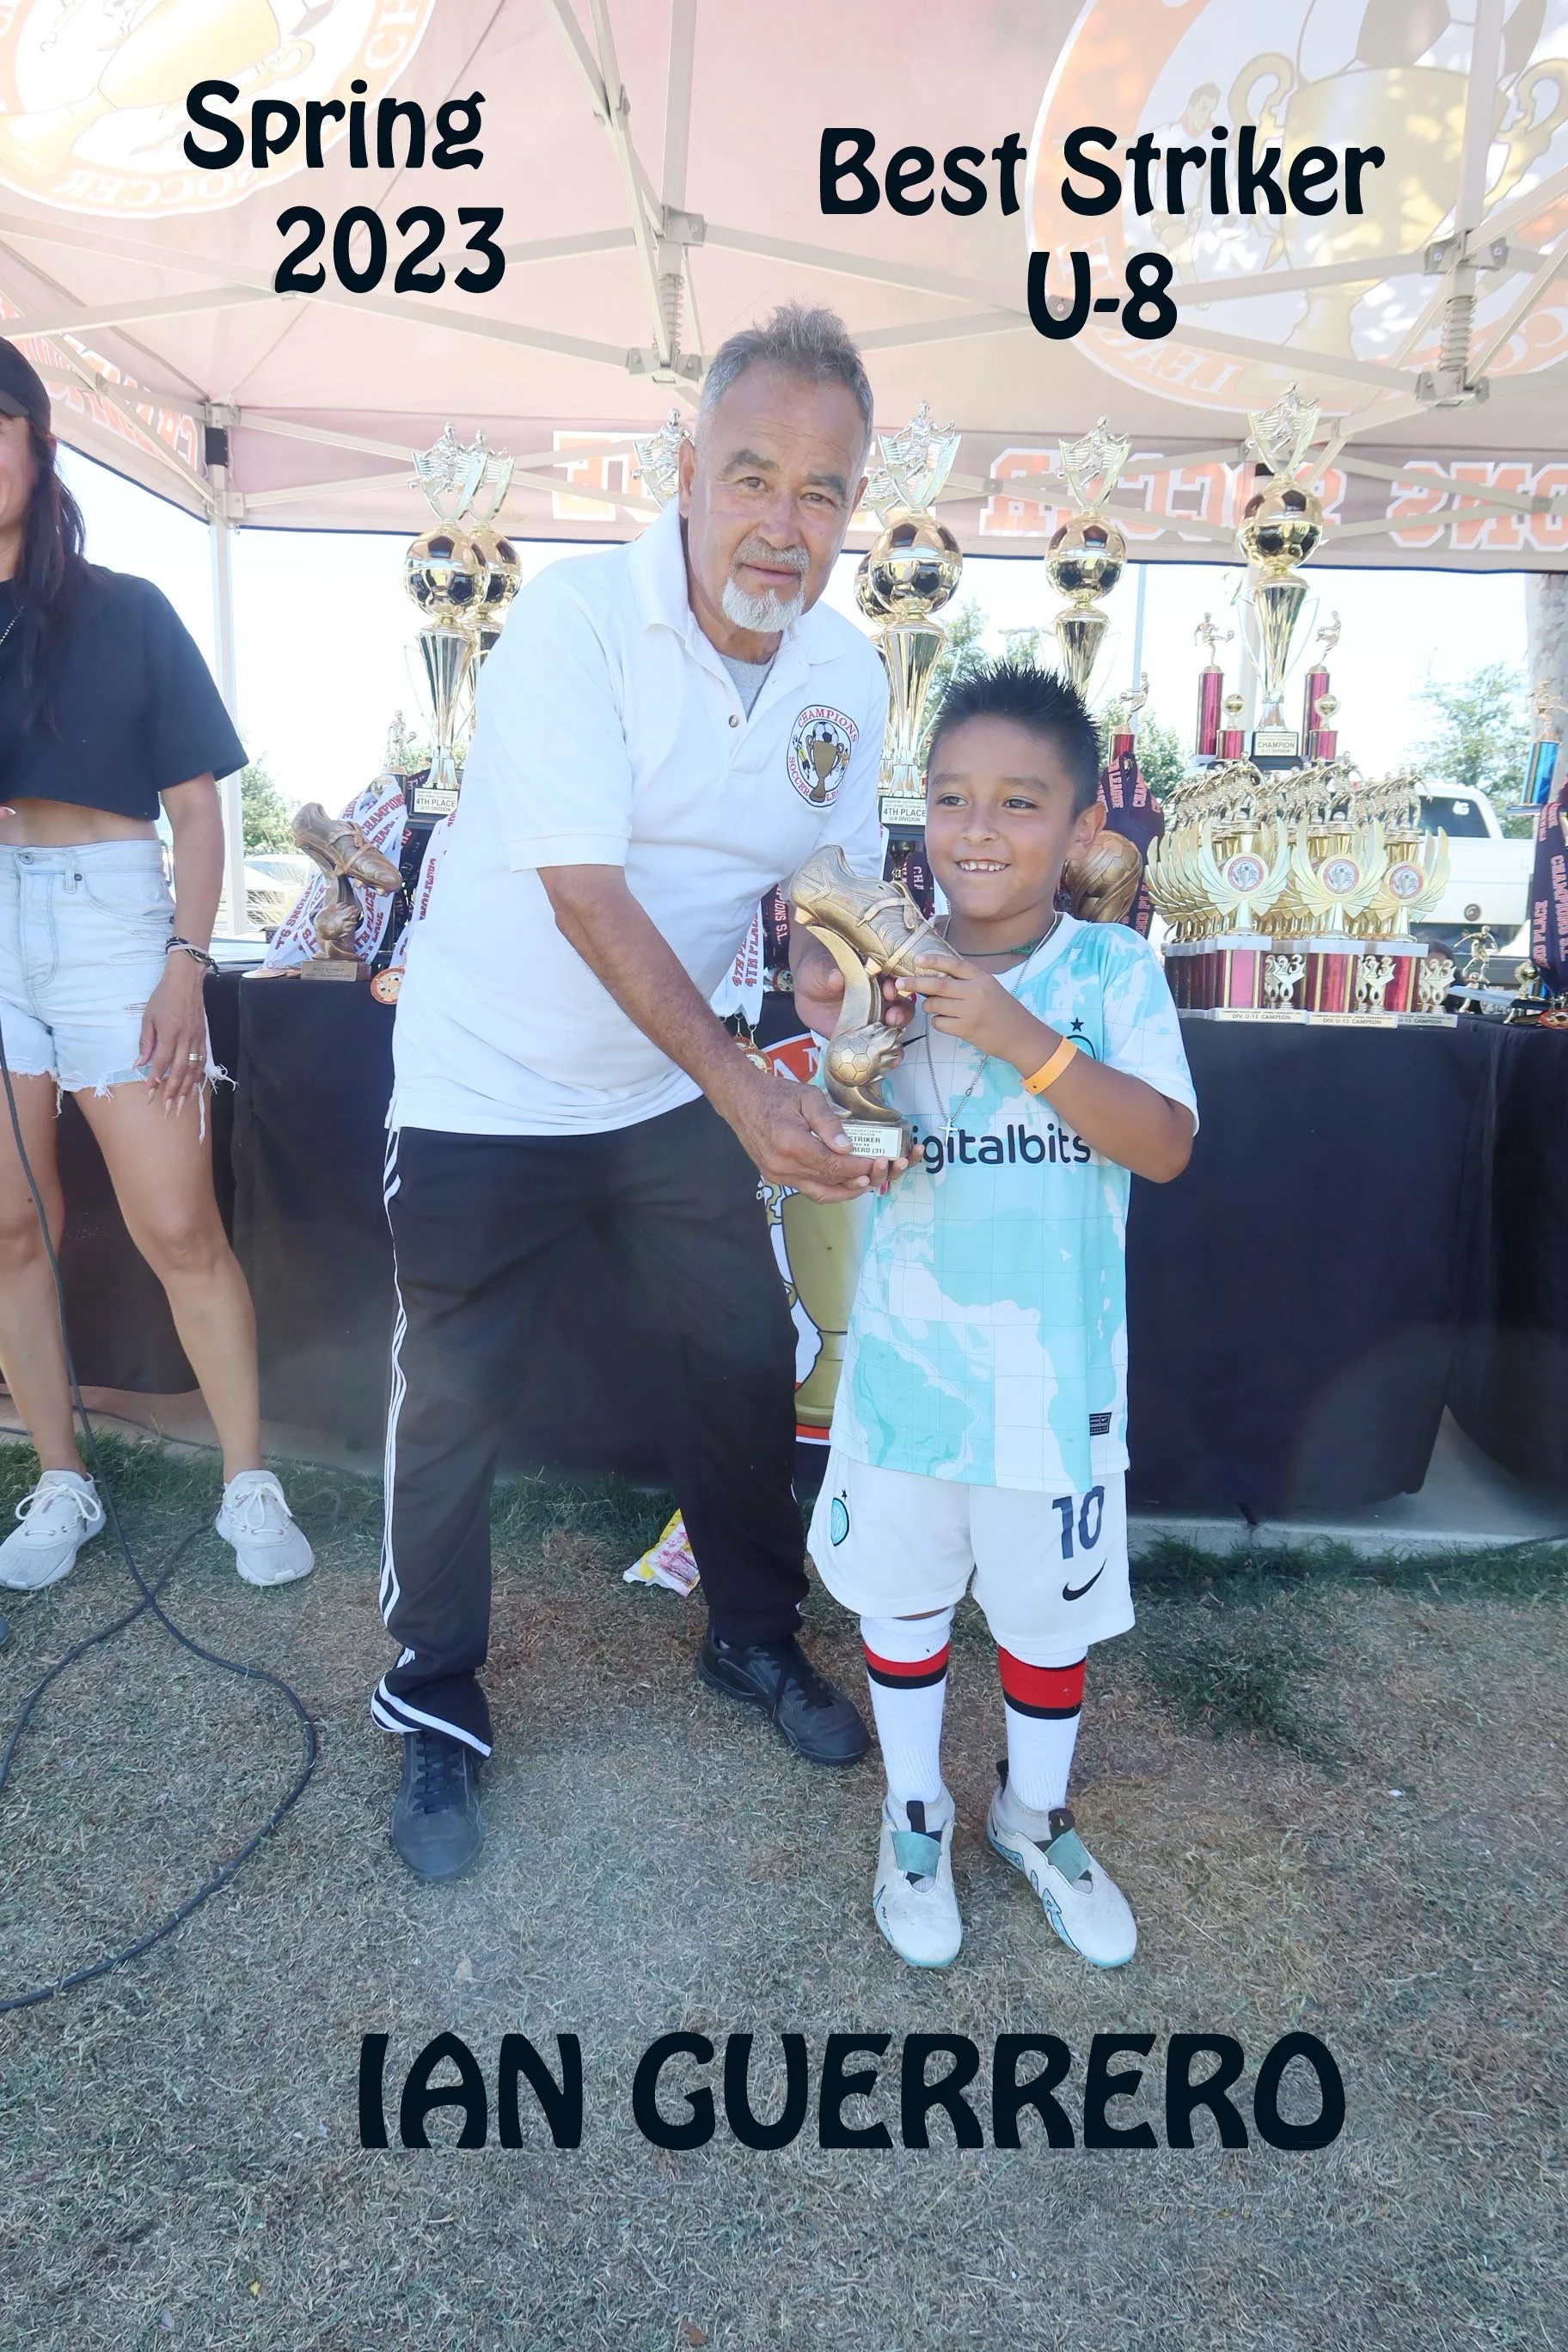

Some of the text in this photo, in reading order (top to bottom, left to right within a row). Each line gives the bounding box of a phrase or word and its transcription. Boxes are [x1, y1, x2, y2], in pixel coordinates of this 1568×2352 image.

[798, 707, 858, 743] CHAMPIONS
[789, 756, 810, 797] SOCCER
[432, 799, 456, 808] PLACE
[883, 807, 928, 818] 4TH PLACE
[1550, 854, 1568, 936] CHAMPIONS
[1533, 900, 1548, 943] PLACE
[744, 956, 758, 988] 4TH
[848, 1136, 881, 1144] STRIKER
[912, 1123, 1091, 1174] igitalbits
[1052, 1485, 1106, 1560] 10
